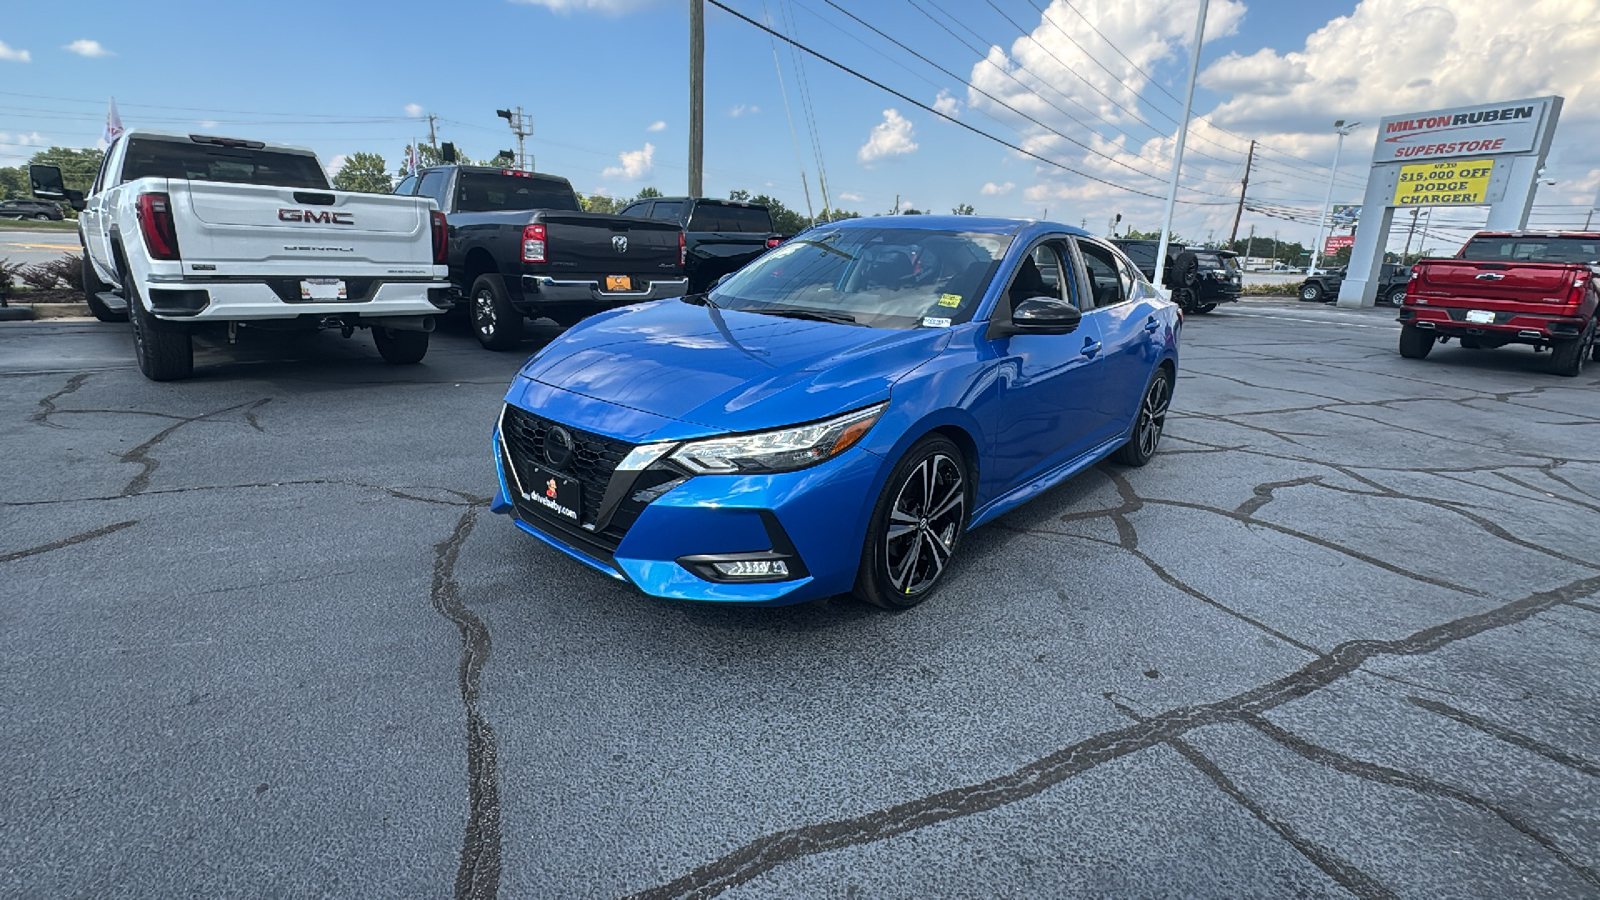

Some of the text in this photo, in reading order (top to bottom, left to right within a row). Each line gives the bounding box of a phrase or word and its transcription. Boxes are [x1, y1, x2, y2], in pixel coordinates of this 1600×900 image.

[1386, 106, 1534, 133] MILTON RUBEN
[1394, 138, 1506, 157] SUPERSTORE
[1400, 168, 1490, 182] $15,000 OFF
[1413, 181, 1469, 193] DODGE
[1400, 193, 1478, 204] CHARGER!
[277, 208, 354, 225] GMC
